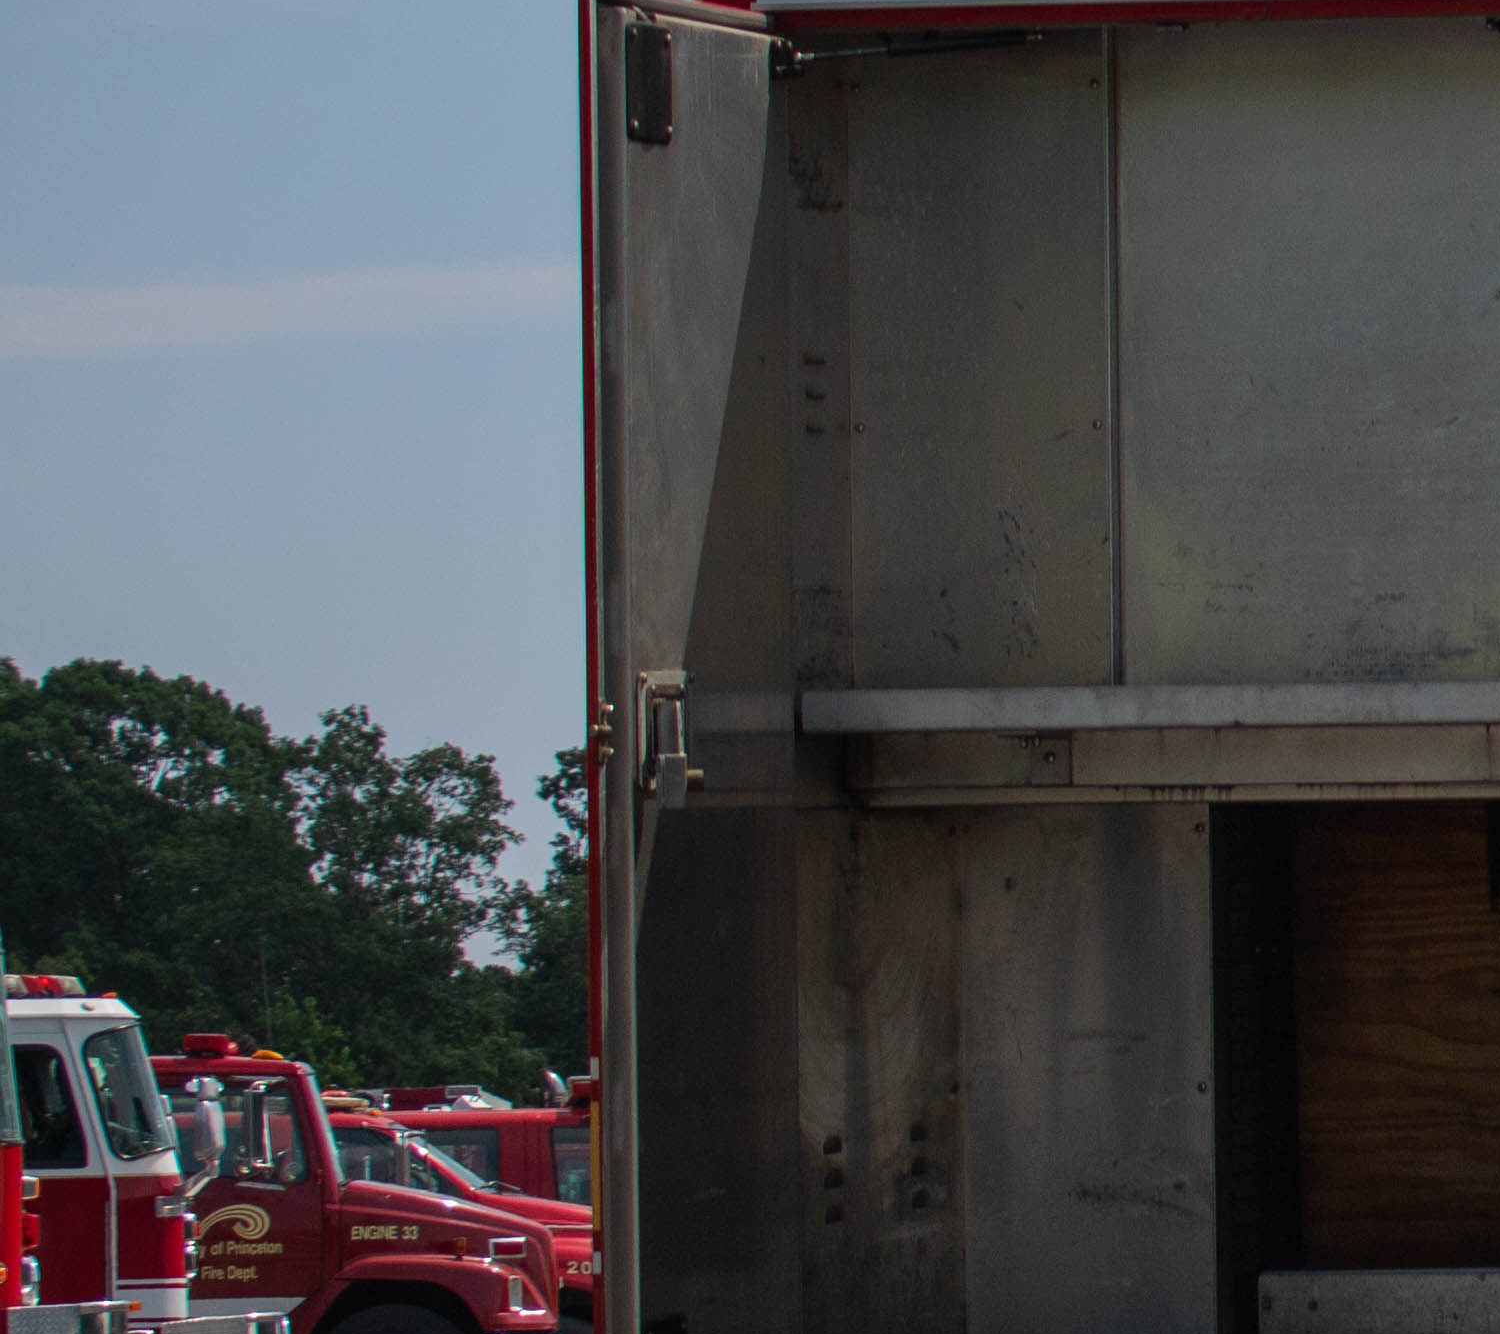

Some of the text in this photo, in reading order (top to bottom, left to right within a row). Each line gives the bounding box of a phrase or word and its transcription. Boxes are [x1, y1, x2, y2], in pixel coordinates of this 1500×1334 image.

[351, 1226, 420, 1240] ENGINE 33
[210, 1241, 224, 1255] of
[226, 1240, 284, 1256] Princeton
[201, 1266, 259, 1283] Fire Dept.
